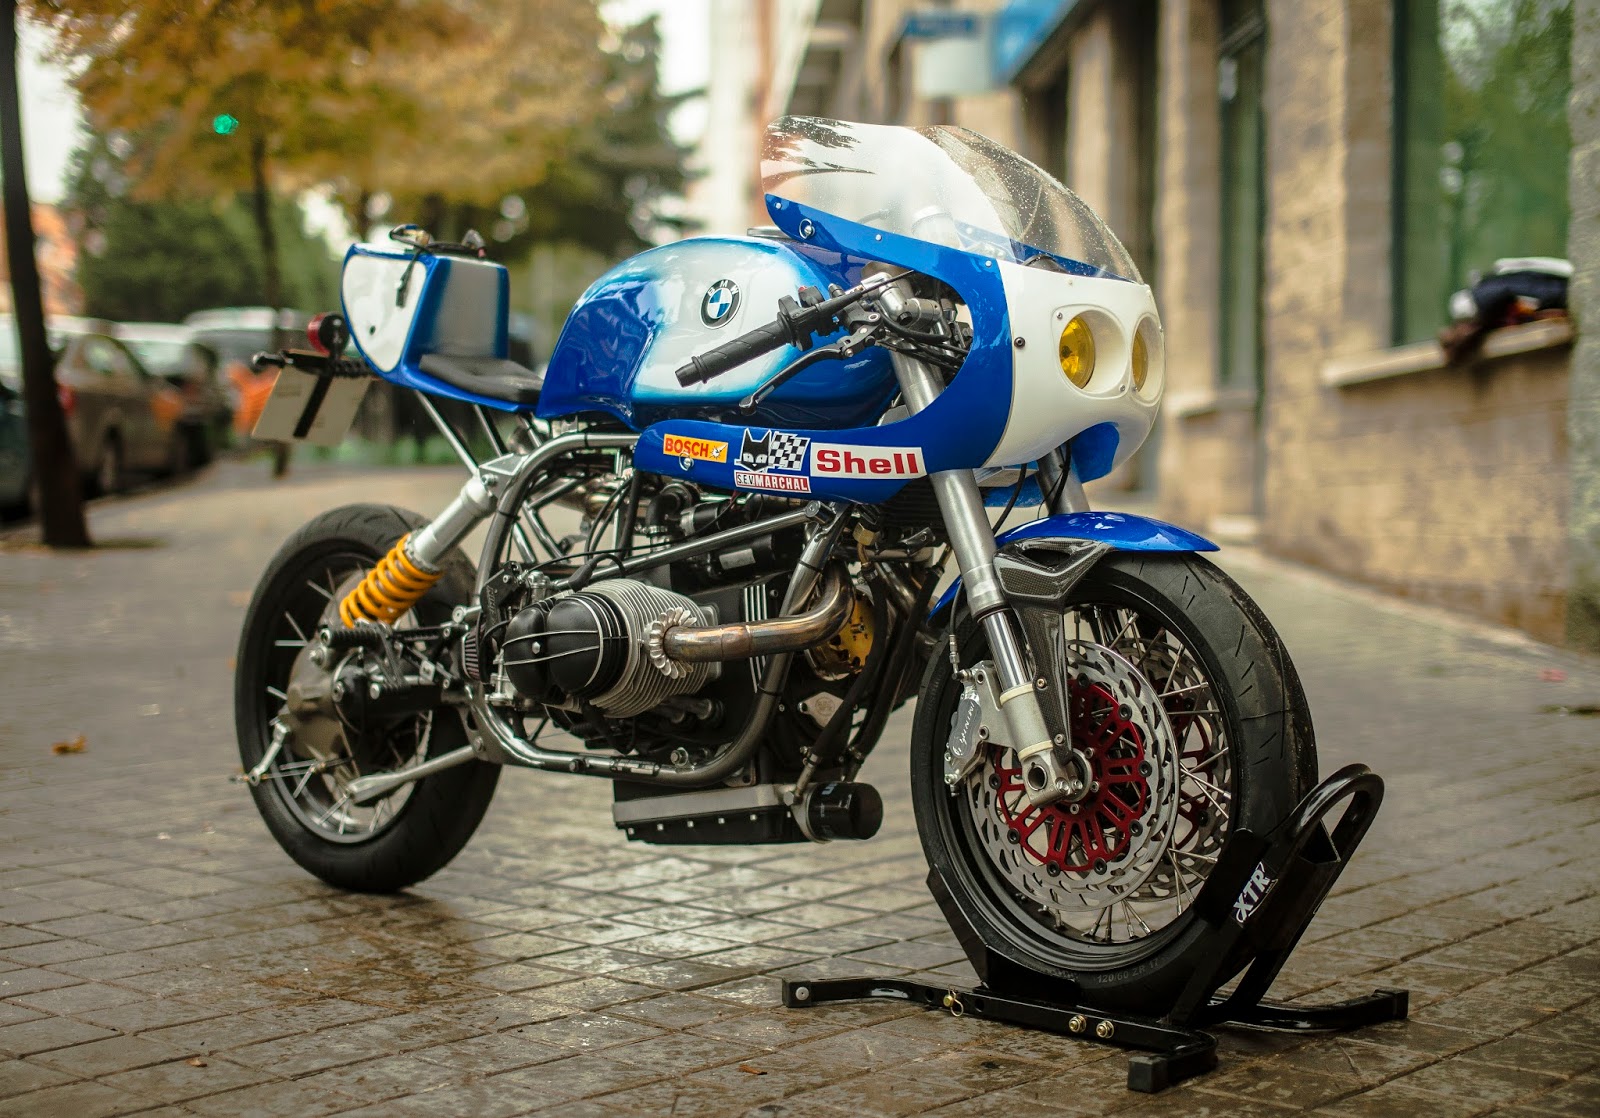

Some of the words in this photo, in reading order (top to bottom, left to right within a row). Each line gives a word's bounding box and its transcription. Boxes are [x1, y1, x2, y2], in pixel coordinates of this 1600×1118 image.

[708, 280, 739, 296] BMW
[664, 437, 709, 458] BOSCH
[816, 449, 919, 474] Shell
[755, 475, 808, 491] MARCHAL
[1233, 868, 1270, 922] XTR
[1097, 970, 1129, 984] 120/60
[1132, 966, 1146, 977] ZR
[1149, 960, 1159, 969] 17
